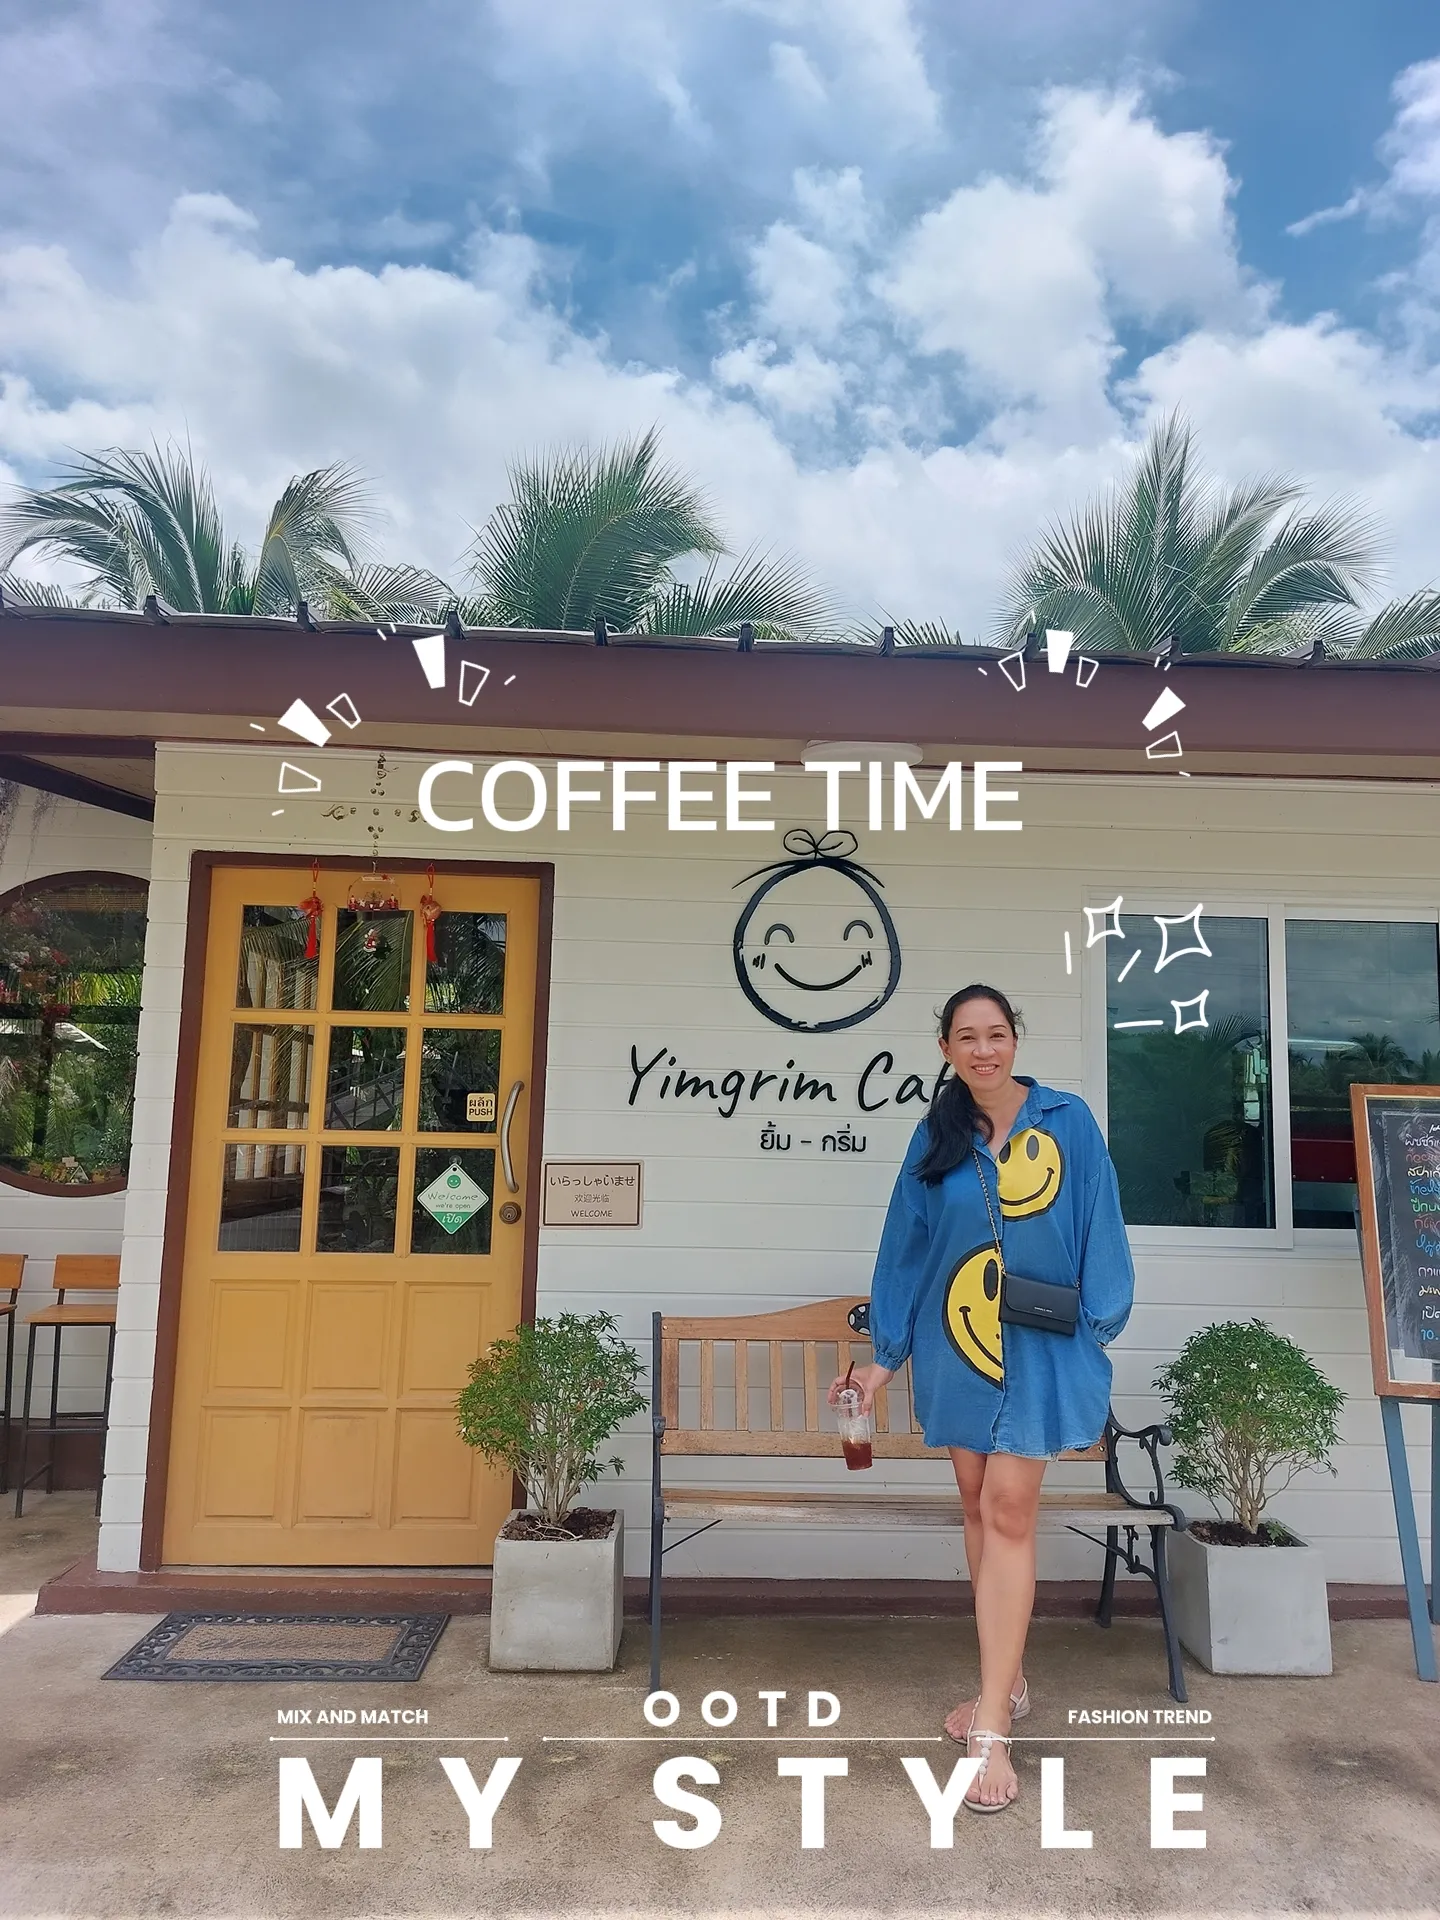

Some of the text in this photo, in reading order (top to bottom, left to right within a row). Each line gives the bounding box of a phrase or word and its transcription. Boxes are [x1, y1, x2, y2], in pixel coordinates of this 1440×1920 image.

[628, 1044, 953, 1119] Yimgrim Caf
[468, 1108, 493, 1116] PUSH
[760, 1121, 791, 1151] ยิ้ม
[550, 1175, 635, 1187] いらっしゃいませ
[428, 1191, 479, 1201] Welcome
[574, 1193, 610, 1203] 欢迎光临
[455, 1203, 471, 1211] open
[441, 1212, 463, 1224] เปิด
[571, 1210, 613, 1218] WELCOME
